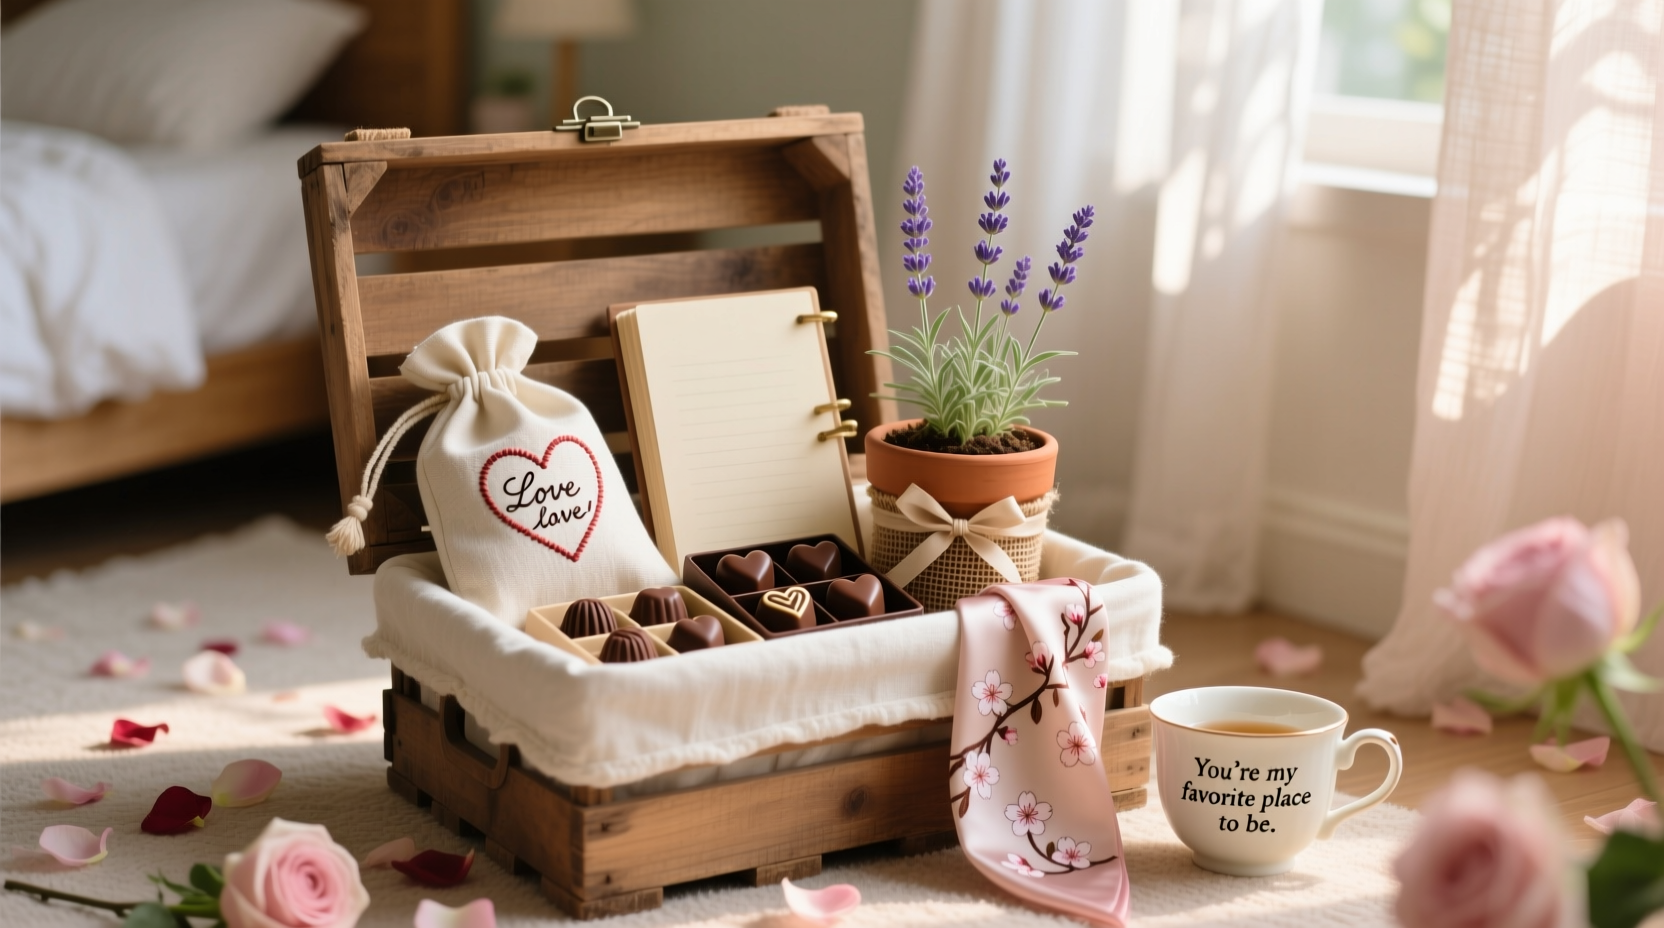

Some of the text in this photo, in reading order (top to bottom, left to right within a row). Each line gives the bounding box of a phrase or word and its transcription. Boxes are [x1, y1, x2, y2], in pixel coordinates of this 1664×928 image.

[503, 471, 581, 513] Love
[1194, 757, 1298, 786] You're my
[1181, 781, 1311, 813] favorite place
[1218, 814, 1276, 833] to be.
